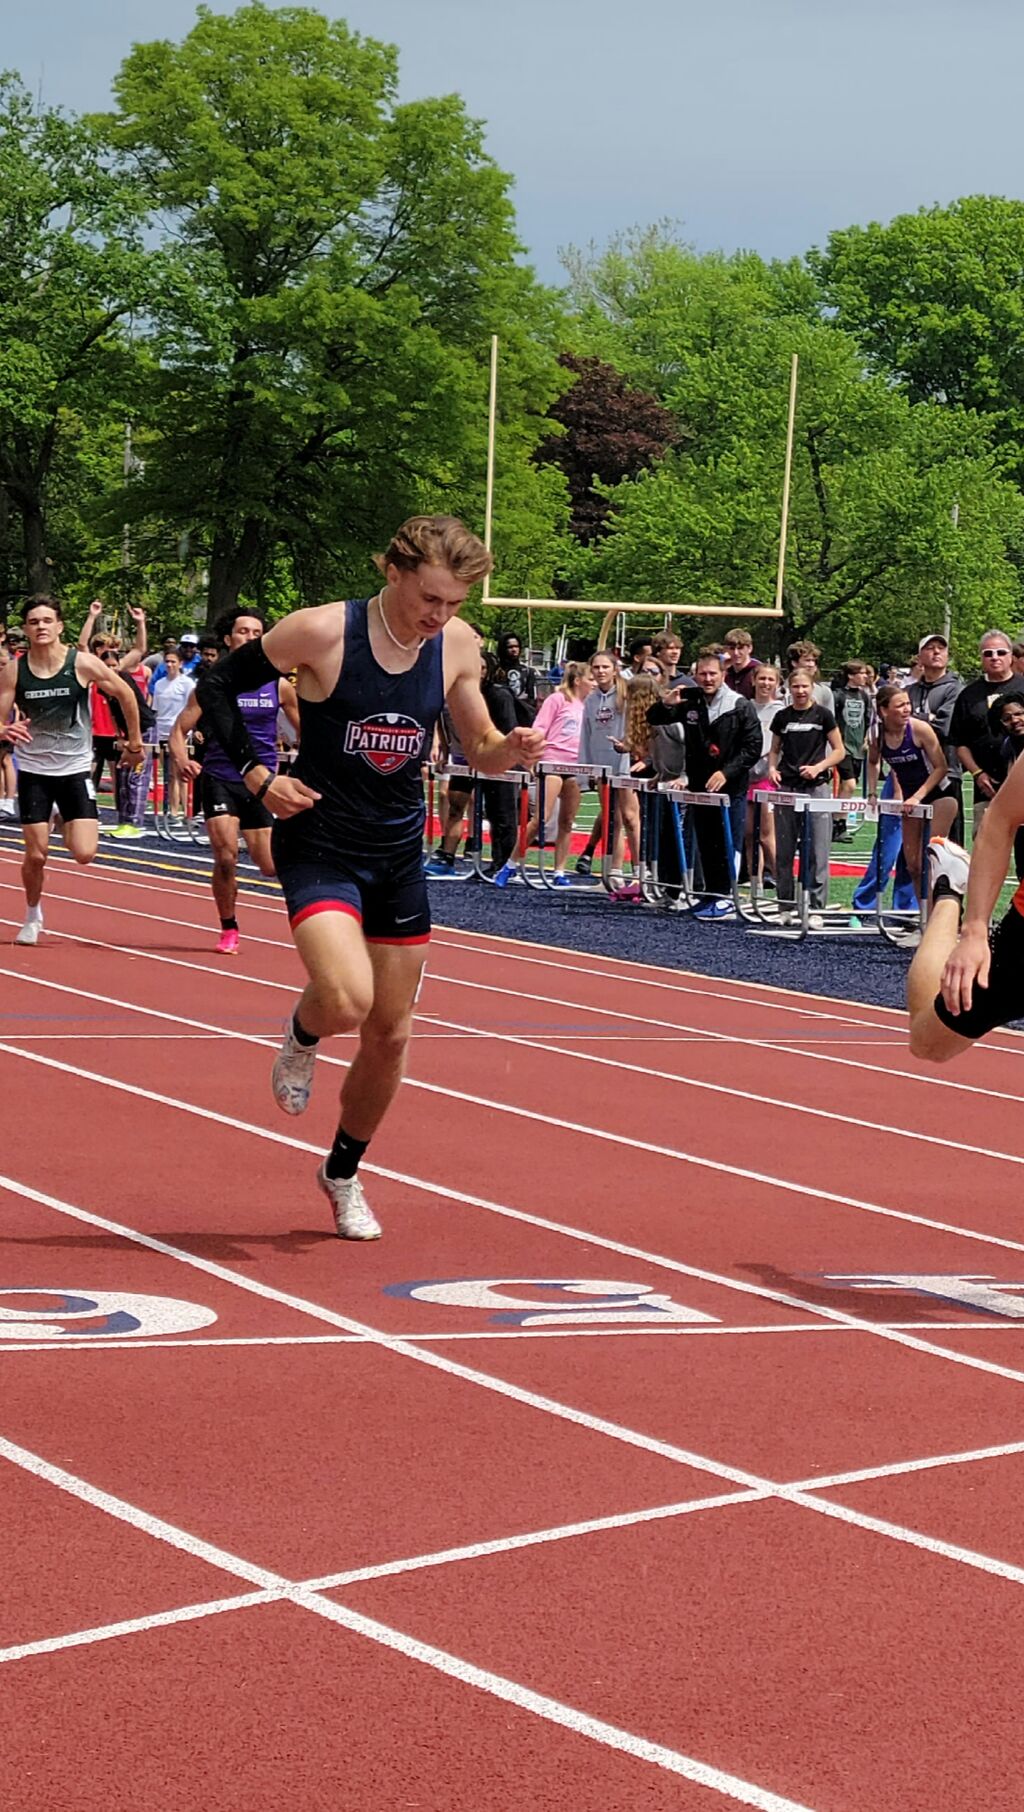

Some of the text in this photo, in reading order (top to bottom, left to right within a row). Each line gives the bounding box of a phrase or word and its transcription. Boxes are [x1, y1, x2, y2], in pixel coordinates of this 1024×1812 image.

[347, 725, 424, 756] PATRIOTS
[841, 801, 867, 811] EDD
[400, 1278, 723, 1326] 5
